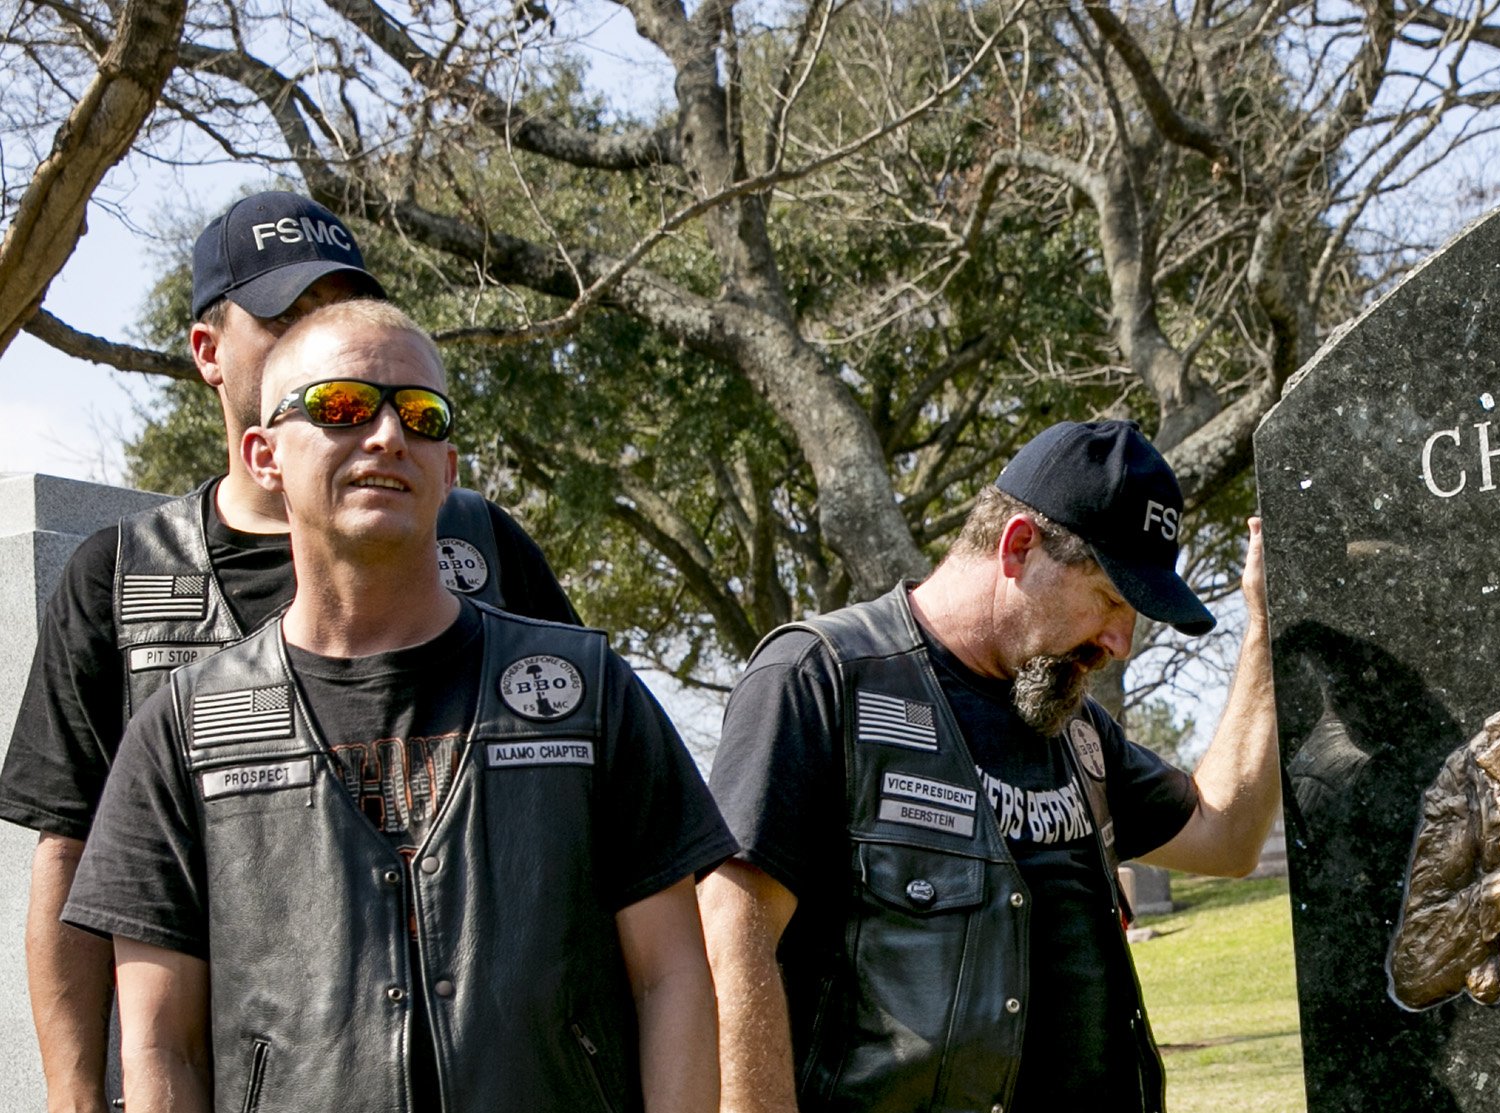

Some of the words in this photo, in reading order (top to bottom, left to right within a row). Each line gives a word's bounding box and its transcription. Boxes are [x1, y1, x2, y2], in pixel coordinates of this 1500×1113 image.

[252, 217, 352, 251] FSMC
[1143, 499, 1183, 542] FS
[147, 652, 163, 663] PIT
[168, 651, 198, 663] STOP
[516, 678, 567, 694] BBO
[496, 746, 535, 761] ALAMO
[540, 745, 589, 760] CHAPTER
[224, 767, 289, 786] PROSPECT
[887, 777, 914, 792] VICE
[915, 783, 974, 806] PRESIDENT
[901, 806, 955, 828] BEERSTEIN
